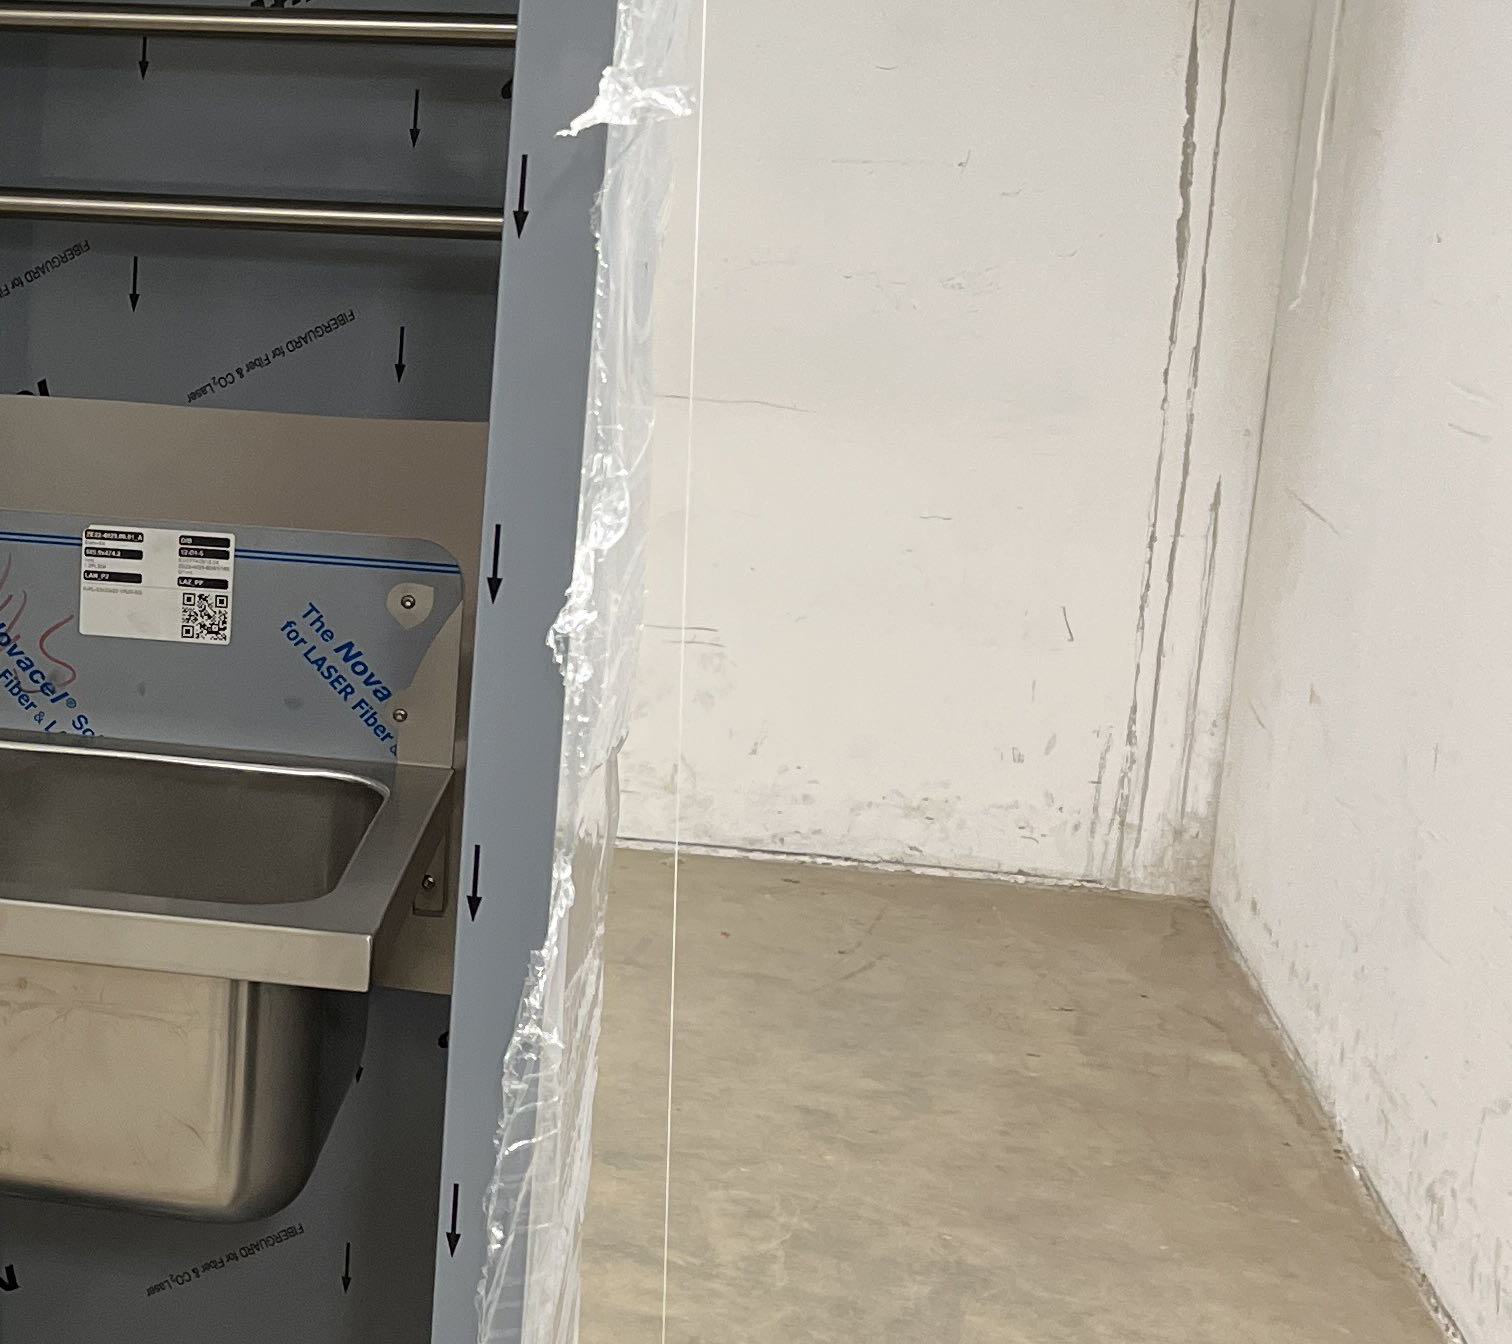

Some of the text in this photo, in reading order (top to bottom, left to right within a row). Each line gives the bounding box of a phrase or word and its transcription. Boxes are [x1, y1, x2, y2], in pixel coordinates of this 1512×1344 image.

[24, 240, 90, 283] FIBERGUARD
[11, 276, 24, 289] for
[286, 310, 355, 352] FIBERGUARD
[272, 346, 285, 359] for
[246, 353, 271, 372] Fiber
[235, 367, 244, 379] &
[187, 383, 215, 403] Laser
[302, 602, 393, 703] The Nova
[280, 620, 394, 742] for LASER Fiber
[33, 711, 46, 724] &
[239, 1223, 304, 1258] FIBERGUARD
[202, 1258, 225, 1273] Fiber
[226, 1252, 239, 1262] for
[192, 1268, 200, 1278] &
[147, 1280, 172, 1297] Laser
